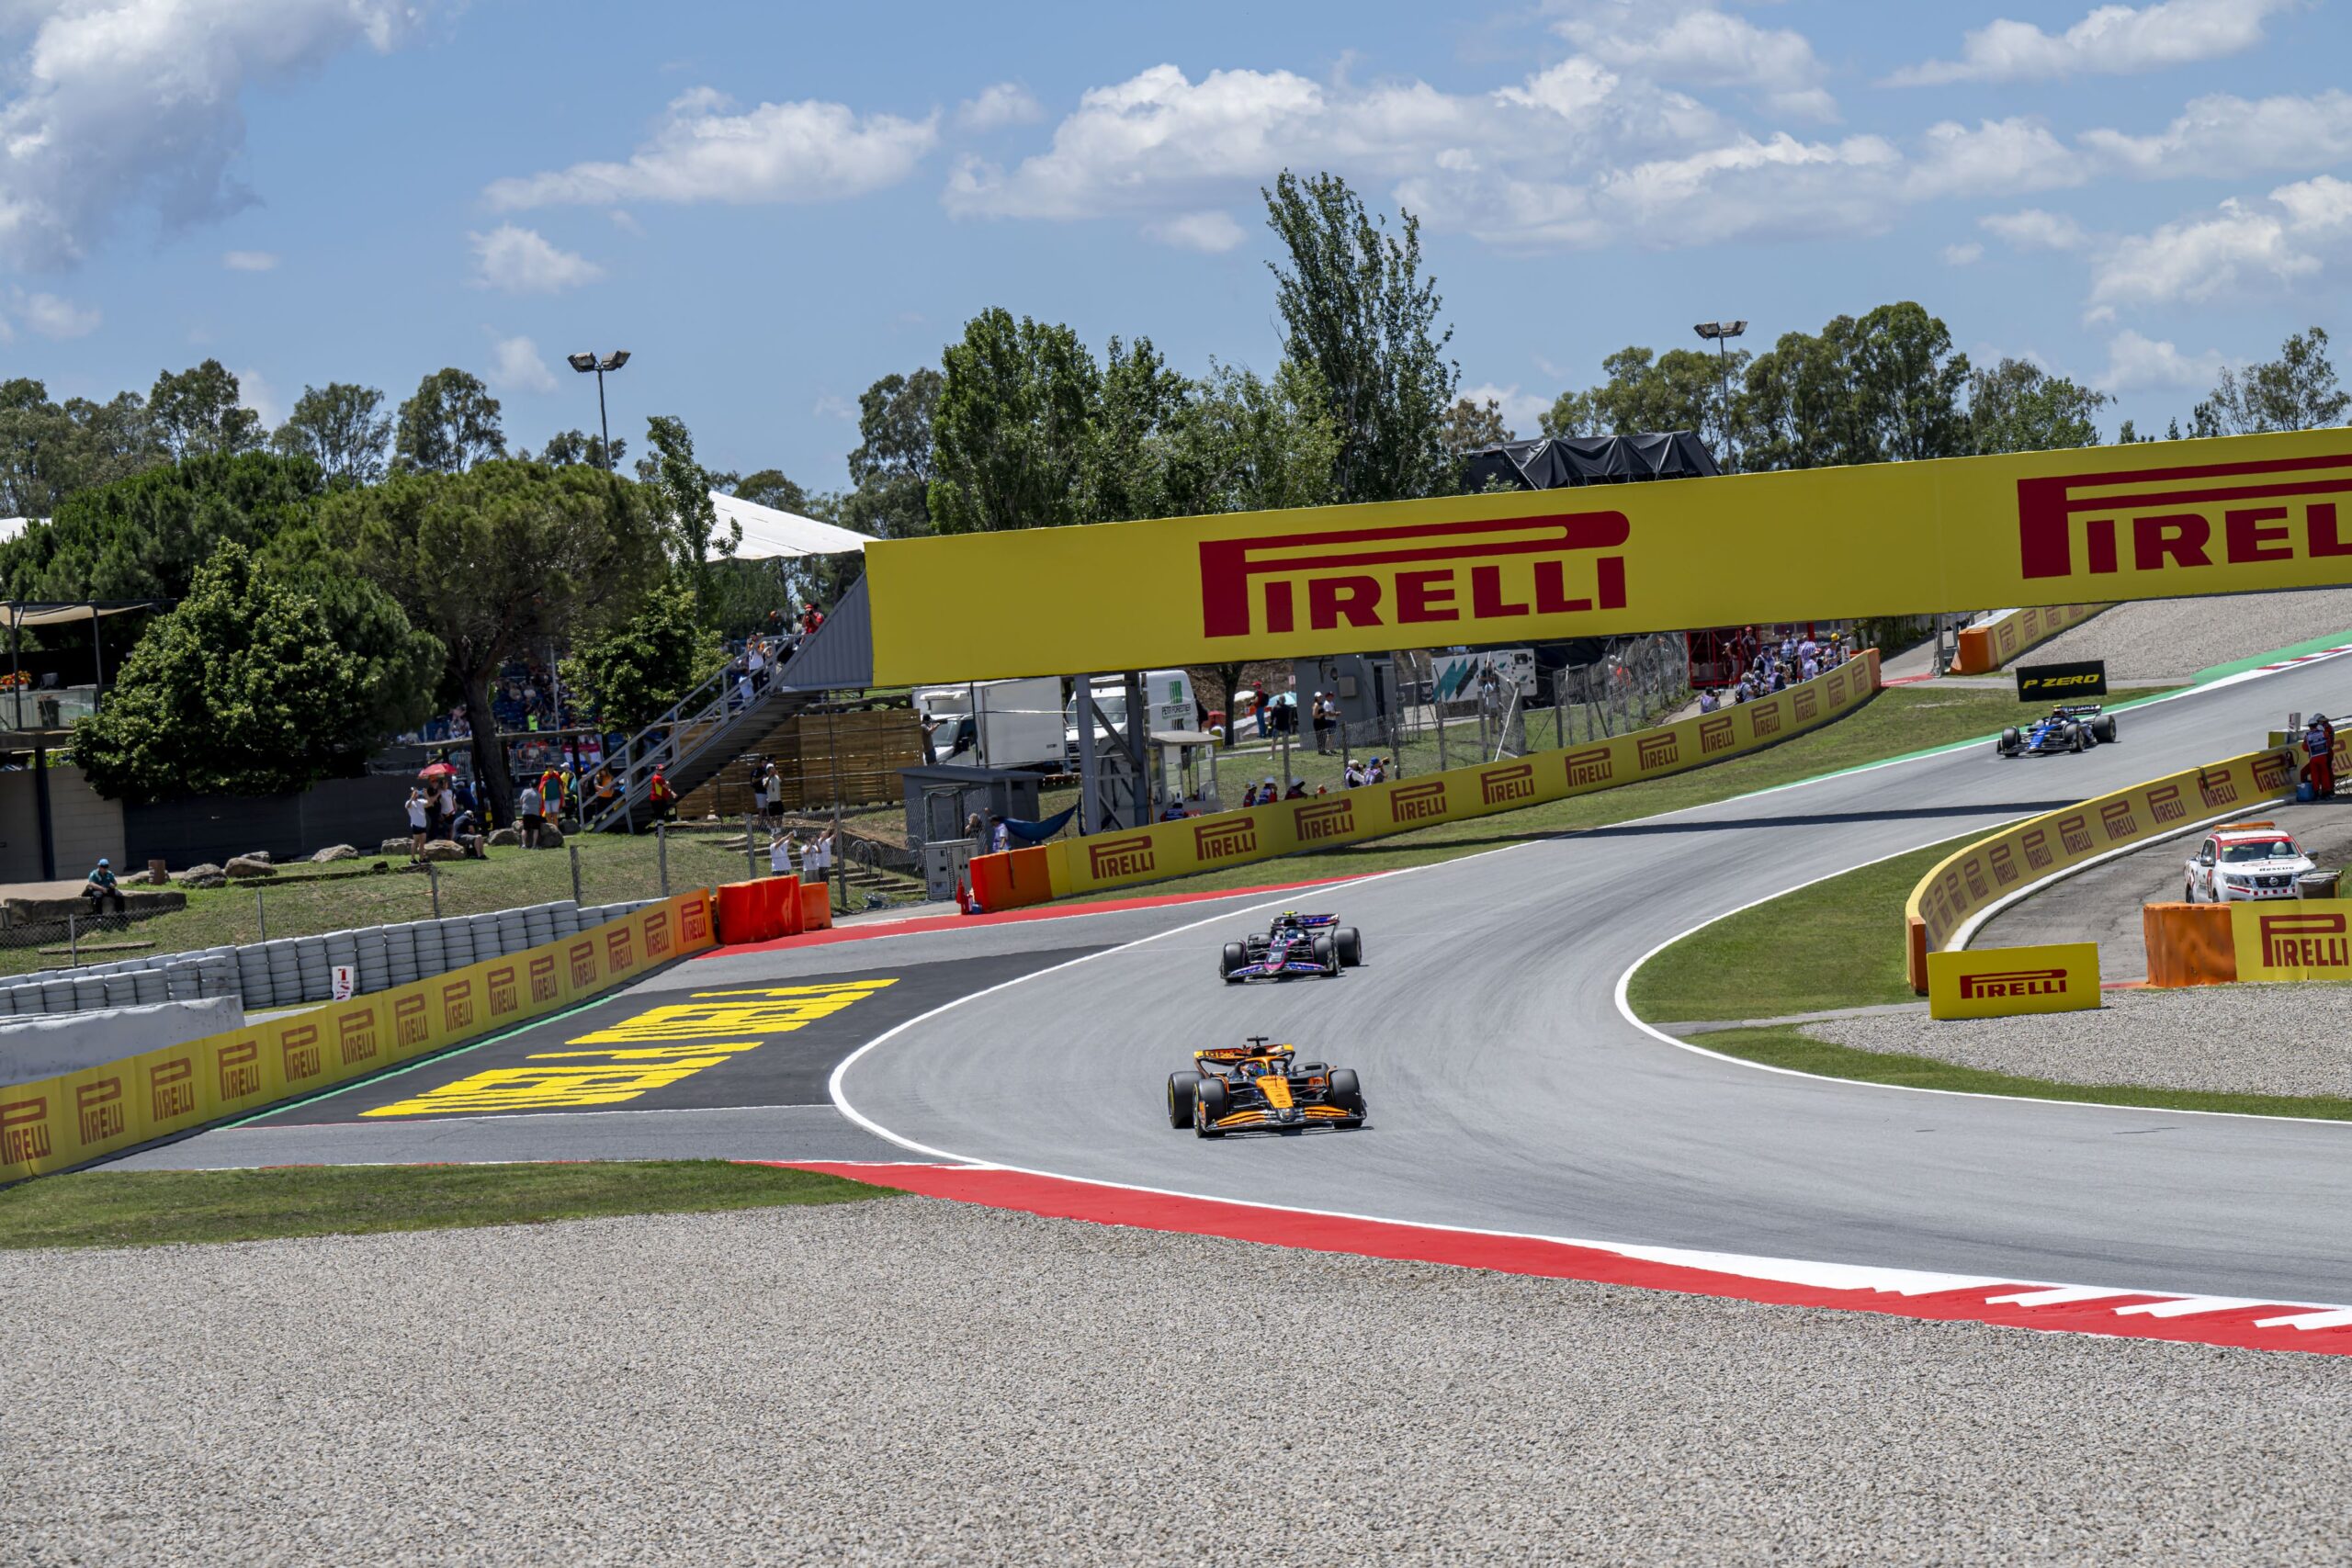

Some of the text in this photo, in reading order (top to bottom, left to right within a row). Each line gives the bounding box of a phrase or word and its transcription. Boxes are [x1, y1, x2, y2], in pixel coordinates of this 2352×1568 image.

[1199, 511, 1630, 637] PIRELLI
[1827, 674, 1845, 709] PIRELLI
[2023, 674, 2100, 689] P ZERO
[1752, 702, 1780, 738] PIRELLI
[1793, 688, 1817, 725] PIRELLI
[1637, 733, 1679, 771] PIRELLI
[1700, 716, 1735, 753] PIRELLI
[1481, 763, 1534, 806] PIRELLI
[1566, 747, 1612, 787] PIRELLI
[2197, 768, 2238, 809] PIRELLI
[1294, 798, 1354, 840] PIRELLI
[1390, 781, 1447, 822] PIRELLI
[2100, 799, 2137, 840] PIRELLI
[2146, 784, 2187, 824] PIRELLI
[1089, 835, 1155, 879] PIRELLI
[1195, 817, 1258, 860] PIRELLI
[2022, 829, 2053, 872] PIRELLI
[2058, 815, 2094, 855] PIRELLI
[1989, 843, 2019, 887] PIRELLI
[645, 911, 671, 958] PIRELLI
[682, 899, 706, 943] PIRELLI
[2259, 914, 2349, 968] PIRELLI
[571, 941, 597, 990] PIRELLI
[606, 927, 631, 974] PIRELLI
[488, 966, 517, 1016] PIRELLI
[530, 954, 557, 1003] PIRELLI
[1960, 968, 2067, 998] PIRELLI
[395, 993, 429, 1047] PIRELLI
[444, 979, 473, 1032] PIRELLI
[281, 1024, 321, 1082] PIRELLI
[339, 1008, 377, 1065] PIRELLI
[150, 1057, 195, 1122] PIRELLI
[218, 1040, 260, 1100] PIRELLI
[0, 1098, 51, 1165] PIRELLI
[77, 1077, 124, 1145] PIRELLI
